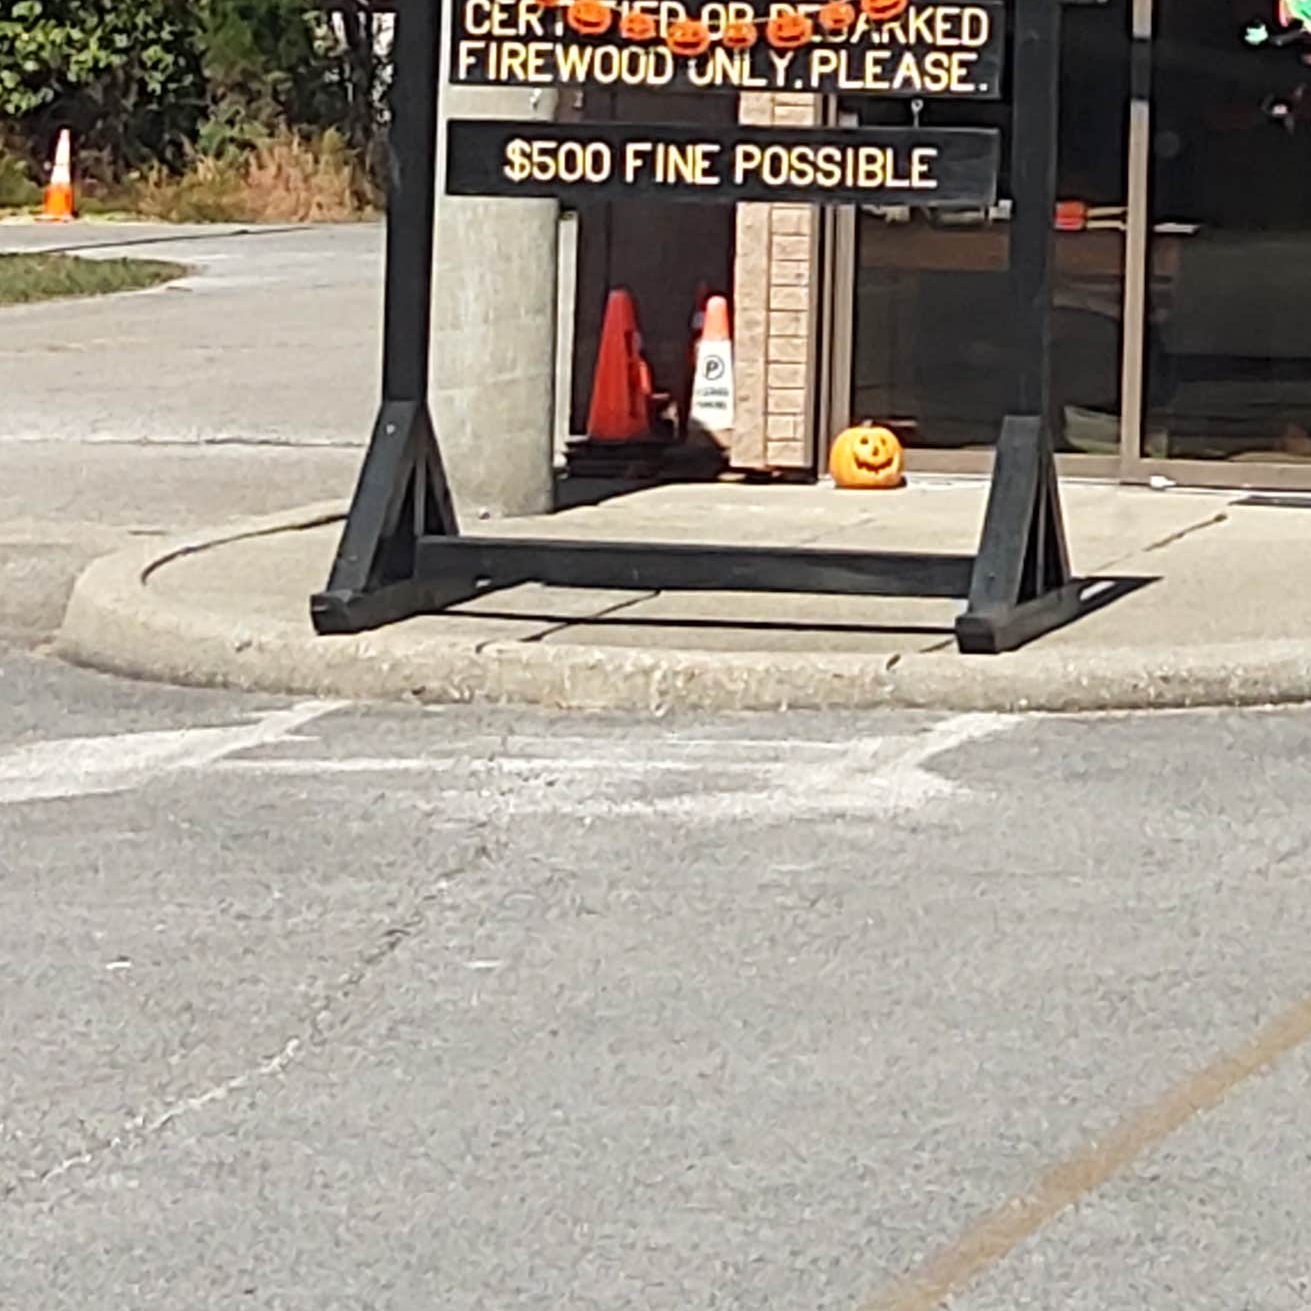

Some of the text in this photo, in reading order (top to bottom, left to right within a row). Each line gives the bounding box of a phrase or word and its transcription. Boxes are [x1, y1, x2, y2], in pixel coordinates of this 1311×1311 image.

[458, 41, 674, 85] FIREWOOD
[810, 48, 988, 92] PLEASE.
[503, 138, 938, 188] $500 FINE POSSIBLE
